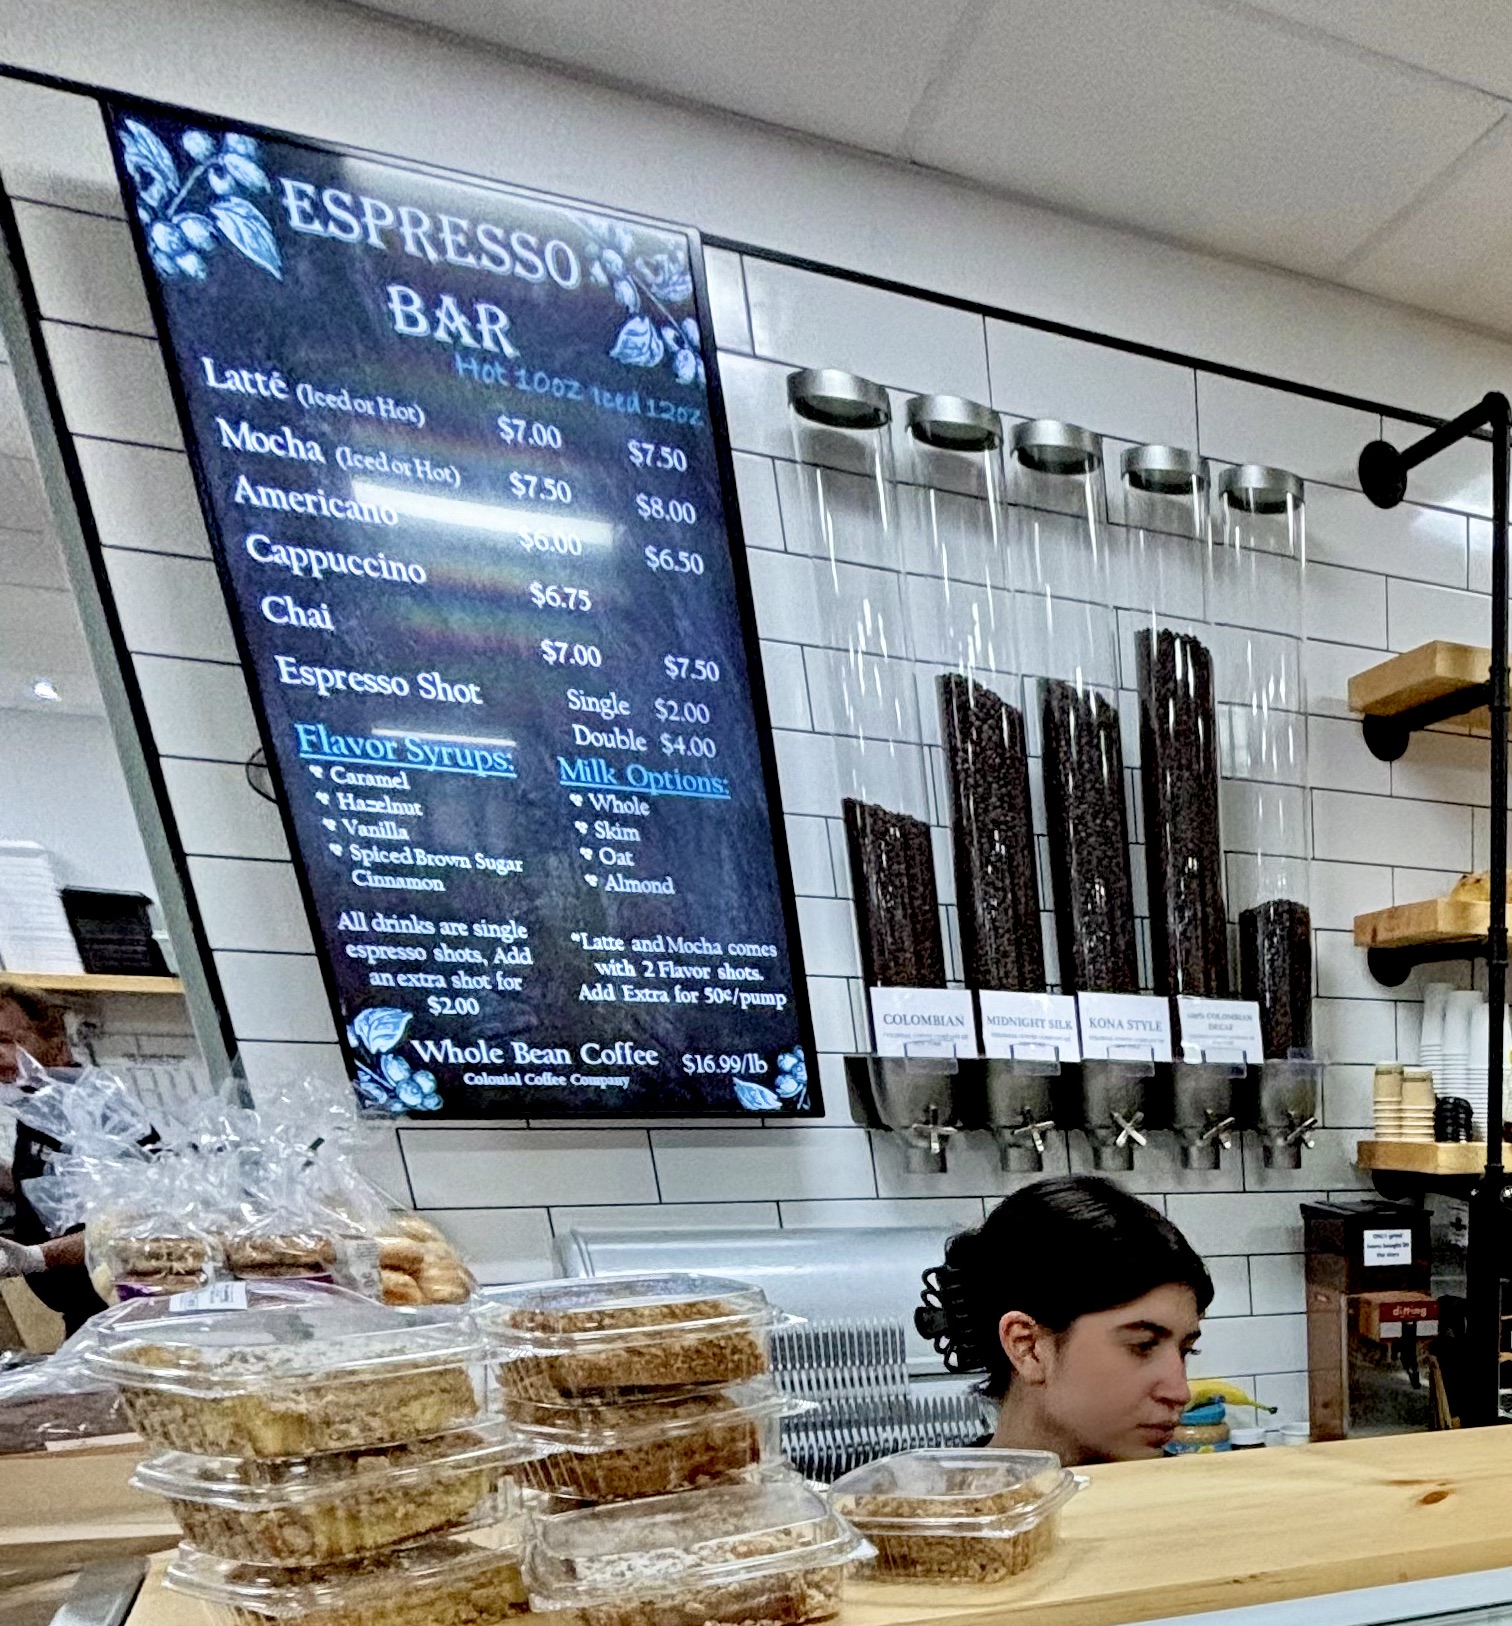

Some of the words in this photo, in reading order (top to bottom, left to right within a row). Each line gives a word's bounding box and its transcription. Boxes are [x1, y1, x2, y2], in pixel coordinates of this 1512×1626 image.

[279, 177, 581, 290] ESPRESSO
[386, 283, 520, 359] BAR
[455, 352, 508, 386] Hot
[201, 356, 290, 400] Latté
[296, 383, 350, 410] (Iced
[353, 398, 375, 416] or
[376, 396, 426, 429] Hot)
[497, 414, 562, 449] $7.00
[627, 439, 687, 472] $7.50
[215, 415, 327, 465] Mocha
[335, 446, 388, 471] (Iced
[391, 460, 412, 478] or
[413, 458, 462, 489] Hot)
[508, 471, 572, 504] $7.50
[635, 492, 696, 525] $8.00
[234, 474, 400, 527] Americano
[517, 527, 583, 556] $6.00
[644, 545, 704, 575] $6.50
[245, 533, 428, 585] Cappuccino
[528, 579, 592, 611] $6.75
[260, 595, 335, 632] Chai
[540, 638, 602, 668] $7.00
[663, 653, 720, 682] $7.50
[273, 653, 410, 698] Espresso
[416, 670, 484, 705] Shot
[567, 688, 631, 721] Single
[654, 697, 710, 725] $2.00
[294, 721, 398, 762] Flavor
[403, 734, 516, 778] Syrups:
[572, 723, 648, 752] Double
[659, 732, 716, 758] $4.00
[329, 765, 412, 791] Caramel
[556, 755, 618, 786] Milk
[625, 763, 731, 797] Options:
[336, 791, 423, 817] Hazelnut
[587, 792, 651, 817] Whole
[340, 817, 411, 841] Vanilla
[594, 820, 641, 843] Skim
[349, 843, 413, 868] Spiced
[413, 847, 472, 870] Brown
[474, 852, 524, 877] Sugar
[598, 846, 635, 867] Oat
[351, 869, 446, 892] Cinnamon
[604, 873, 676, 895] Almond
[337, 910, 370, 932] All
[371, 912, 436, 936] drinks
[439, 920, 470, 937] are
[472, 918, 529, 944] single
[345, 943, 428, 965] espresso
[432, 942, 489, 967] shots,
[492, 946, 534, 966] Add
[631, 934, 665, 953] and
[666, 936, 724, 956] Mocha
[727, 941, 778, 958] comes
[368, 971, 396, 987] an
[397, 971, 447, 989] extra
[451, 970, 493, 990] shot
[495, 970, 523, 991] for
[593, 958, 637, 978] with
[641, 960, 655, 978] 2
[657, 960, 712, 980] Flavor
[717, 962, 765, 982] shots.
[577, 982, 616, 1002] Add
[620, 984, 670, 1003] Extra
[674, 985, 699, 1004] for
[883, 1012, 966, 1028] COLOMBIAN
[986, 1015, 1046, 1030] MIDNIGHT
[1047, 1018, 1074, 1031] SILK
[1088, 1017, 1125, 1030] KONA
[1126, 1019, 1164, 1033] STYLE
[411, 1039, 504, 1065] Whole
[510, 1040, 573, 1066] Bean
[579, 1041, 660, 1067] Coffee
[681, 1052, 769, 1077] $16.99/lb
[462, 1071, 522, 1087] Colonial
[523, 1072, 567, 1087] Coffee
[569, 1072, 631, 1090] Company
